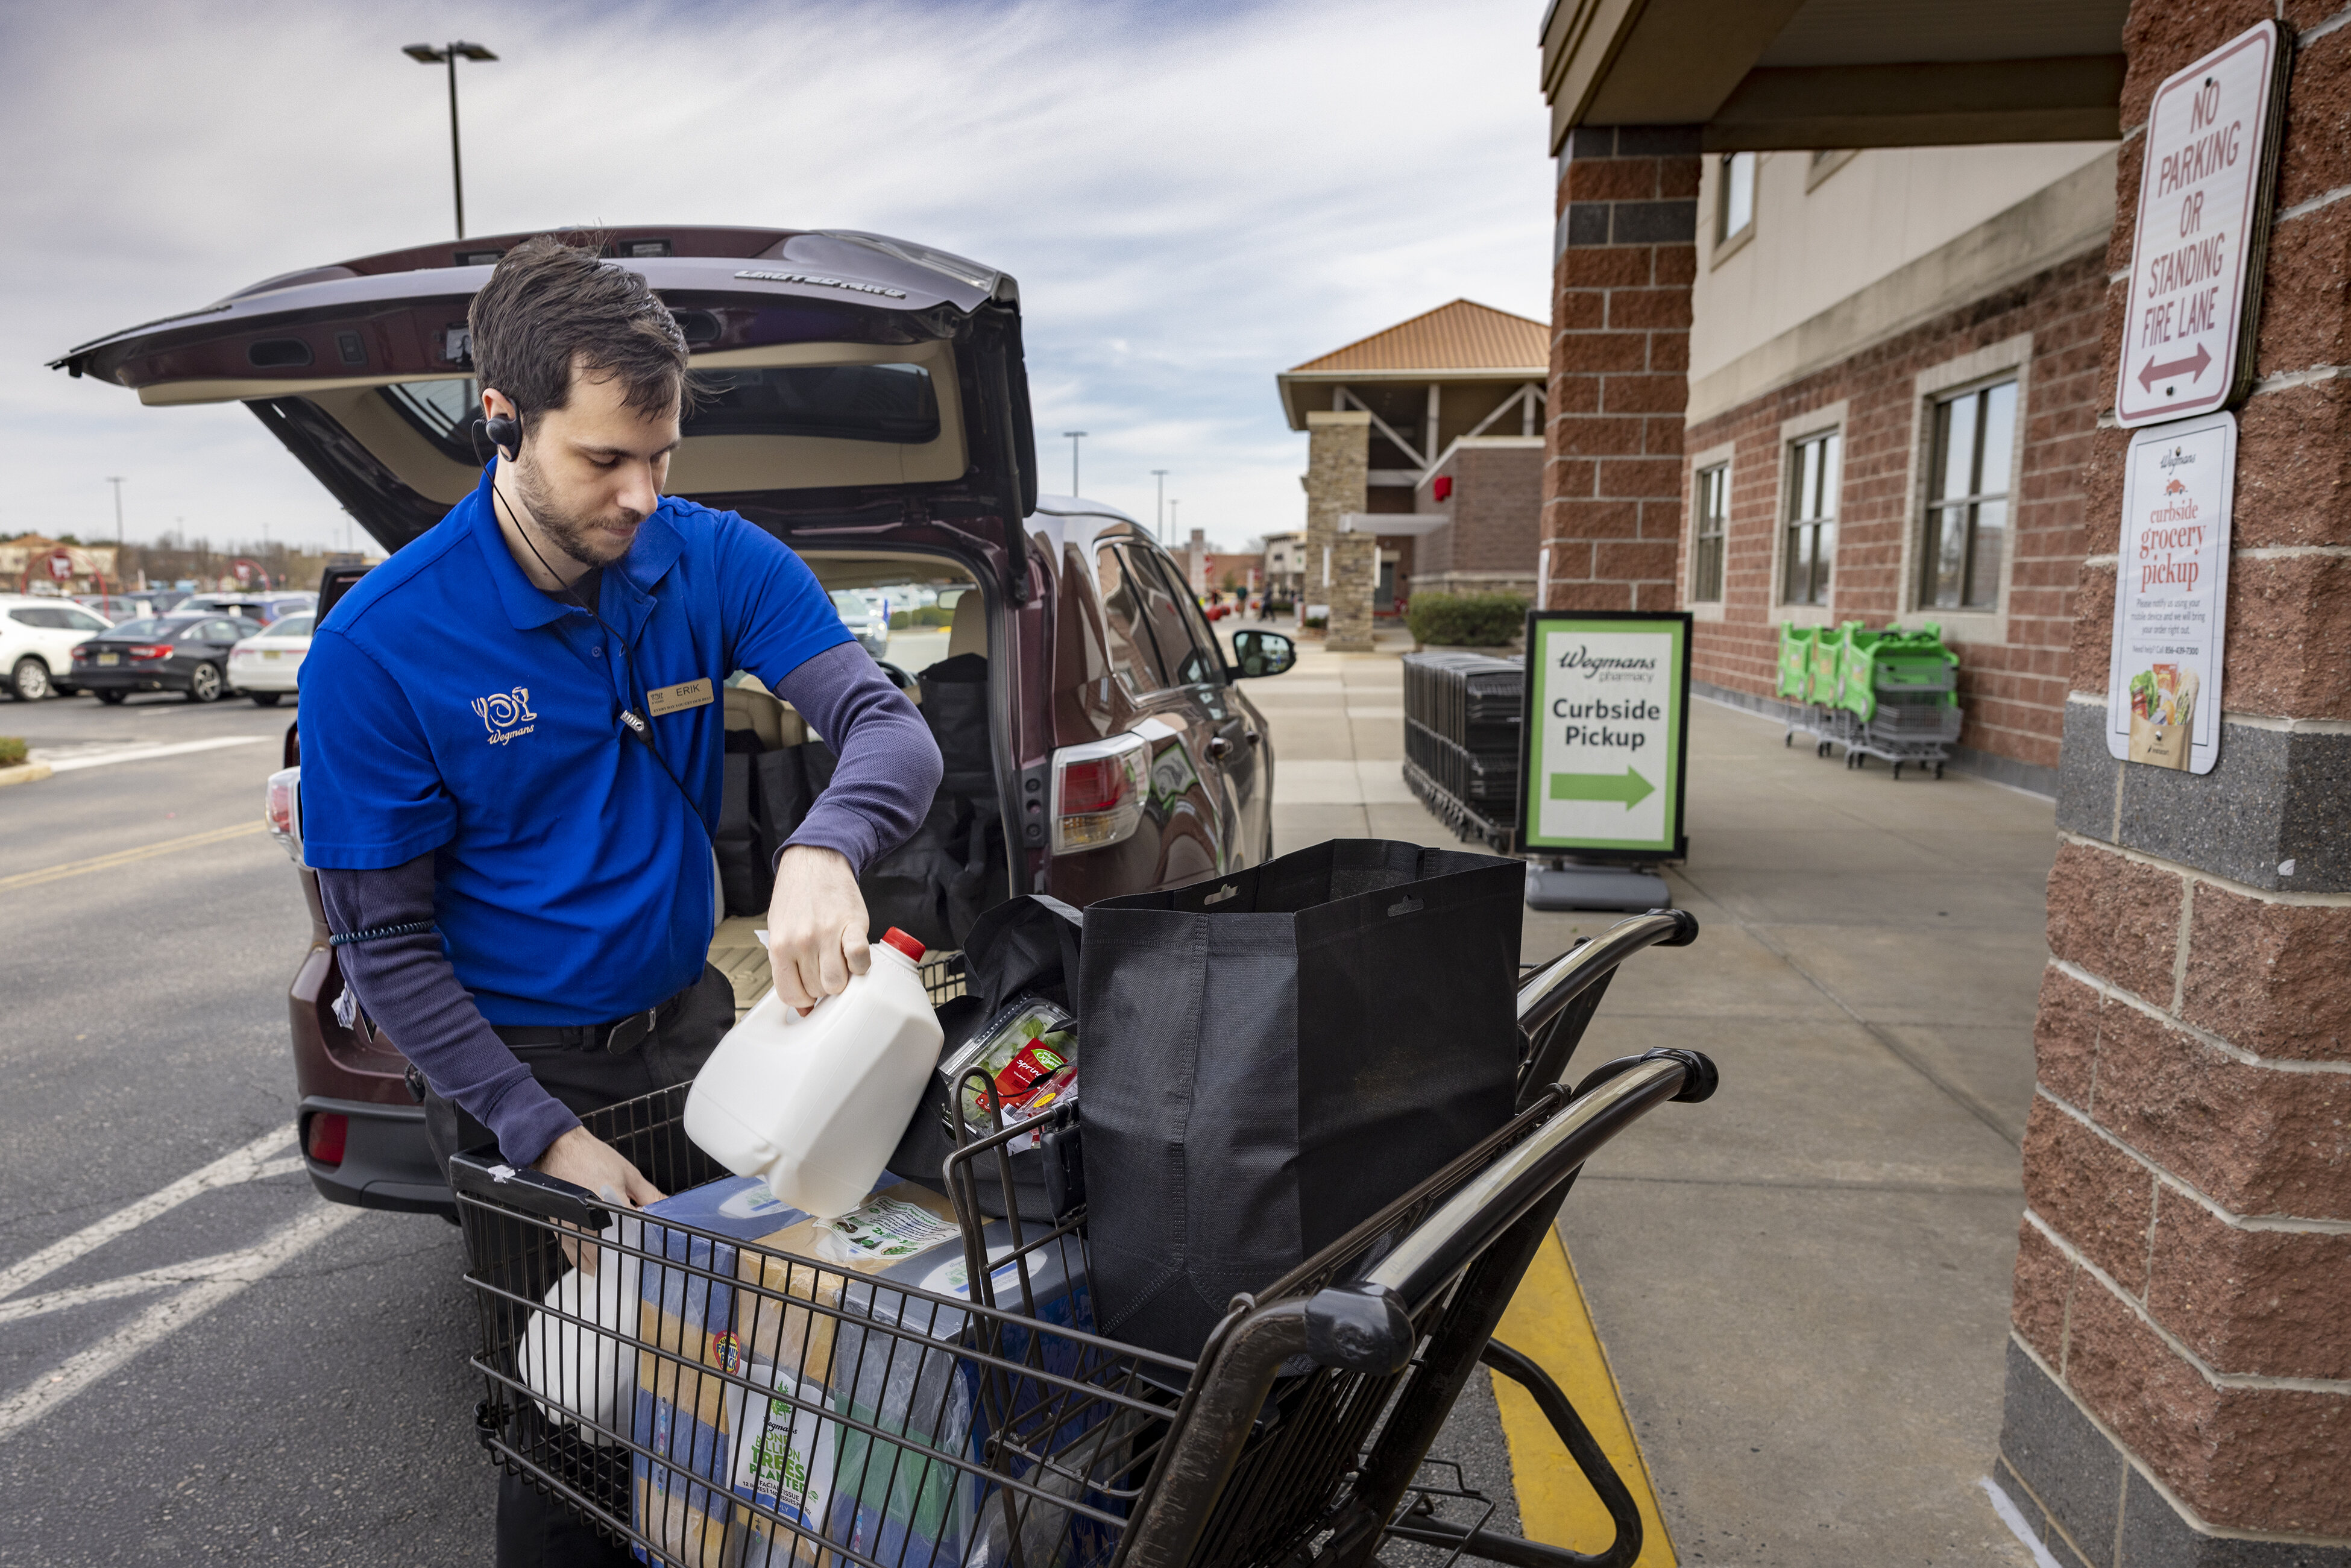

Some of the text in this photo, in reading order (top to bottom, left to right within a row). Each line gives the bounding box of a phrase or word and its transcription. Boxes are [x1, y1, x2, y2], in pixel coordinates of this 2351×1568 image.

[2190, 80, 2220, 134] NO
[2157, 121, 2241, 198] PARKING
[2180, 191, 2204, 238] OR
[2148, 233, 2224, 298] STANDING
[2142, 286, 2219, 348] FIRE LANE
[2161, 448, 2196, 475] Wegmans
[2150, 498, 2198, 523] curbside
[2140, 525, 2206, 559] grocery
[2141, 553, 2198, 593] pickup
[1558, 645, 1655, 679] Wegmans
[676, 684, 700, 696] ERIK
[1599, 670, 1654, 683] pharmacy
[1553, 699, 1661, 720] Curbside
[488, 724, 534, 745] Wegmans
[1566, 726, 1645, 752] Pickup
[720, 1355, 737, 1370] PCK
[763, 1413, 798, 1434] egmas
[756, 1435, 800, 1463] BLLION
[751, 1445, 805, 1481] TREES
[750, 1483, 766, 1492] BXES
[780, 1494, 796, 1505] ISSUES
